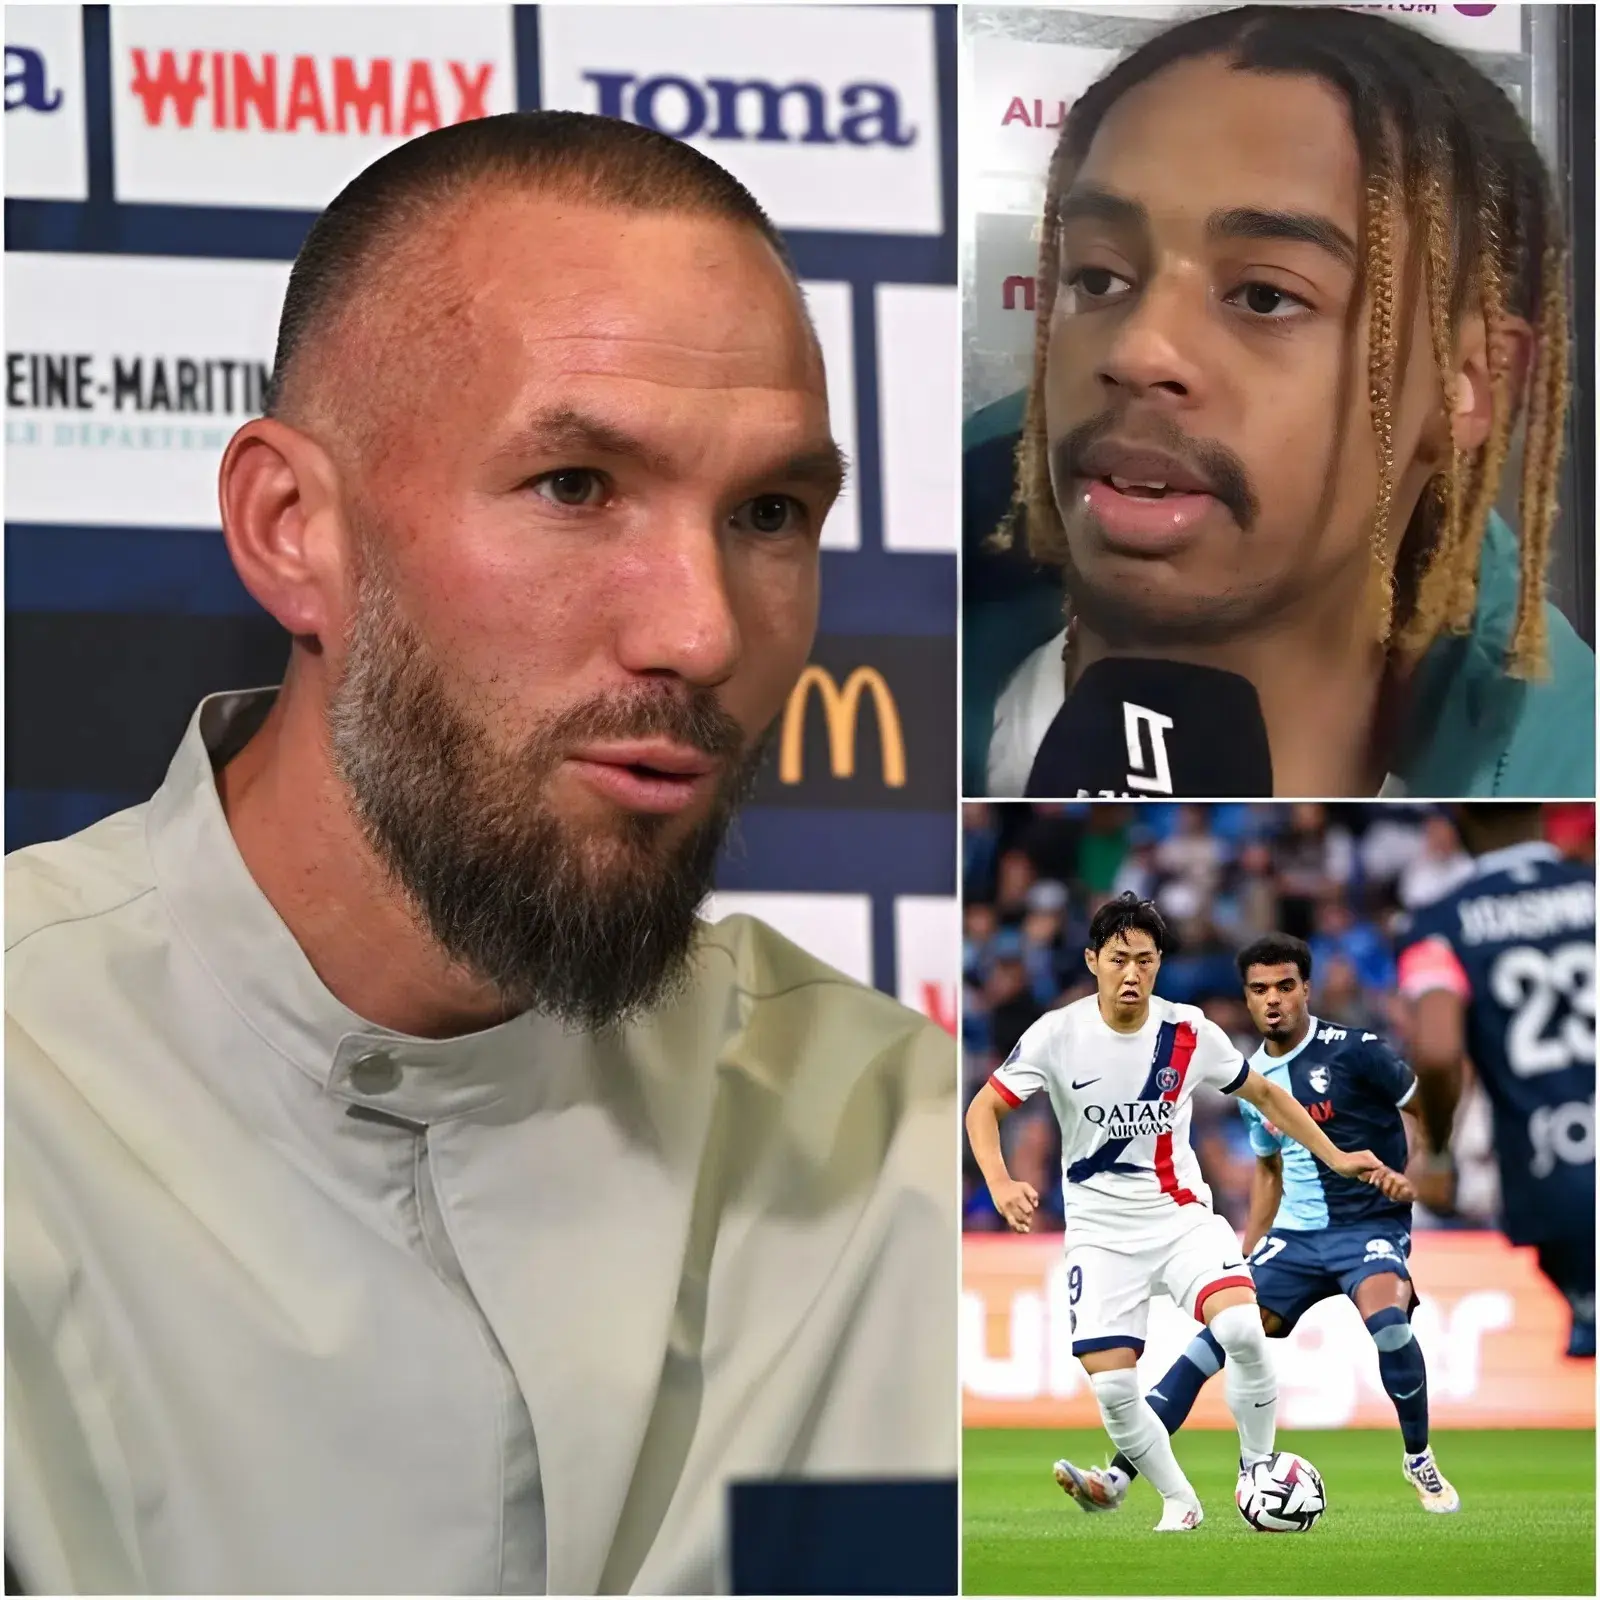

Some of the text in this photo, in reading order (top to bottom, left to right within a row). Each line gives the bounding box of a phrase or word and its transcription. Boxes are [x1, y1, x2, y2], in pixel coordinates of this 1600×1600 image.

[130, 48, 495, 136] WINAMAX
[1491, 944, 1596, 1079] 23
[1083, 1101, 1173, 1128] QATAR
